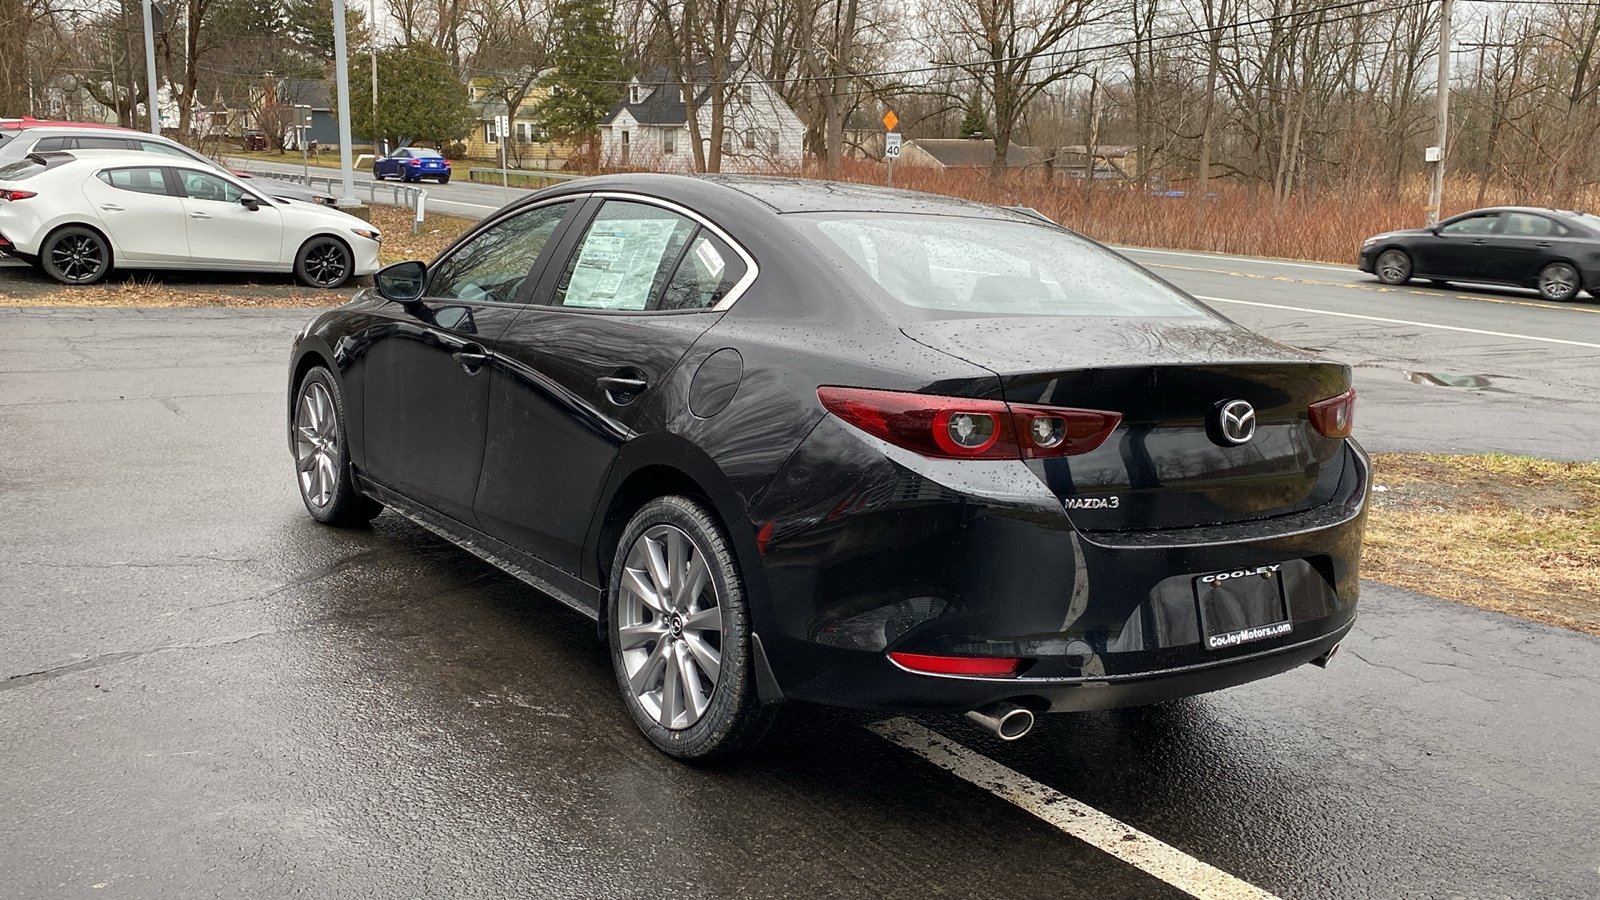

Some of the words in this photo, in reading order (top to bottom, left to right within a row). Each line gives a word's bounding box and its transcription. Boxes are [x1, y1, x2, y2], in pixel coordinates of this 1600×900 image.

[887, 146, 900, 155] 40
[1064, 496, 1119, 509] MAZDA3
[1202, 564, 1280, 583] COOLEY
[1209, 623, 1291, 647] CooleyMotors.com
